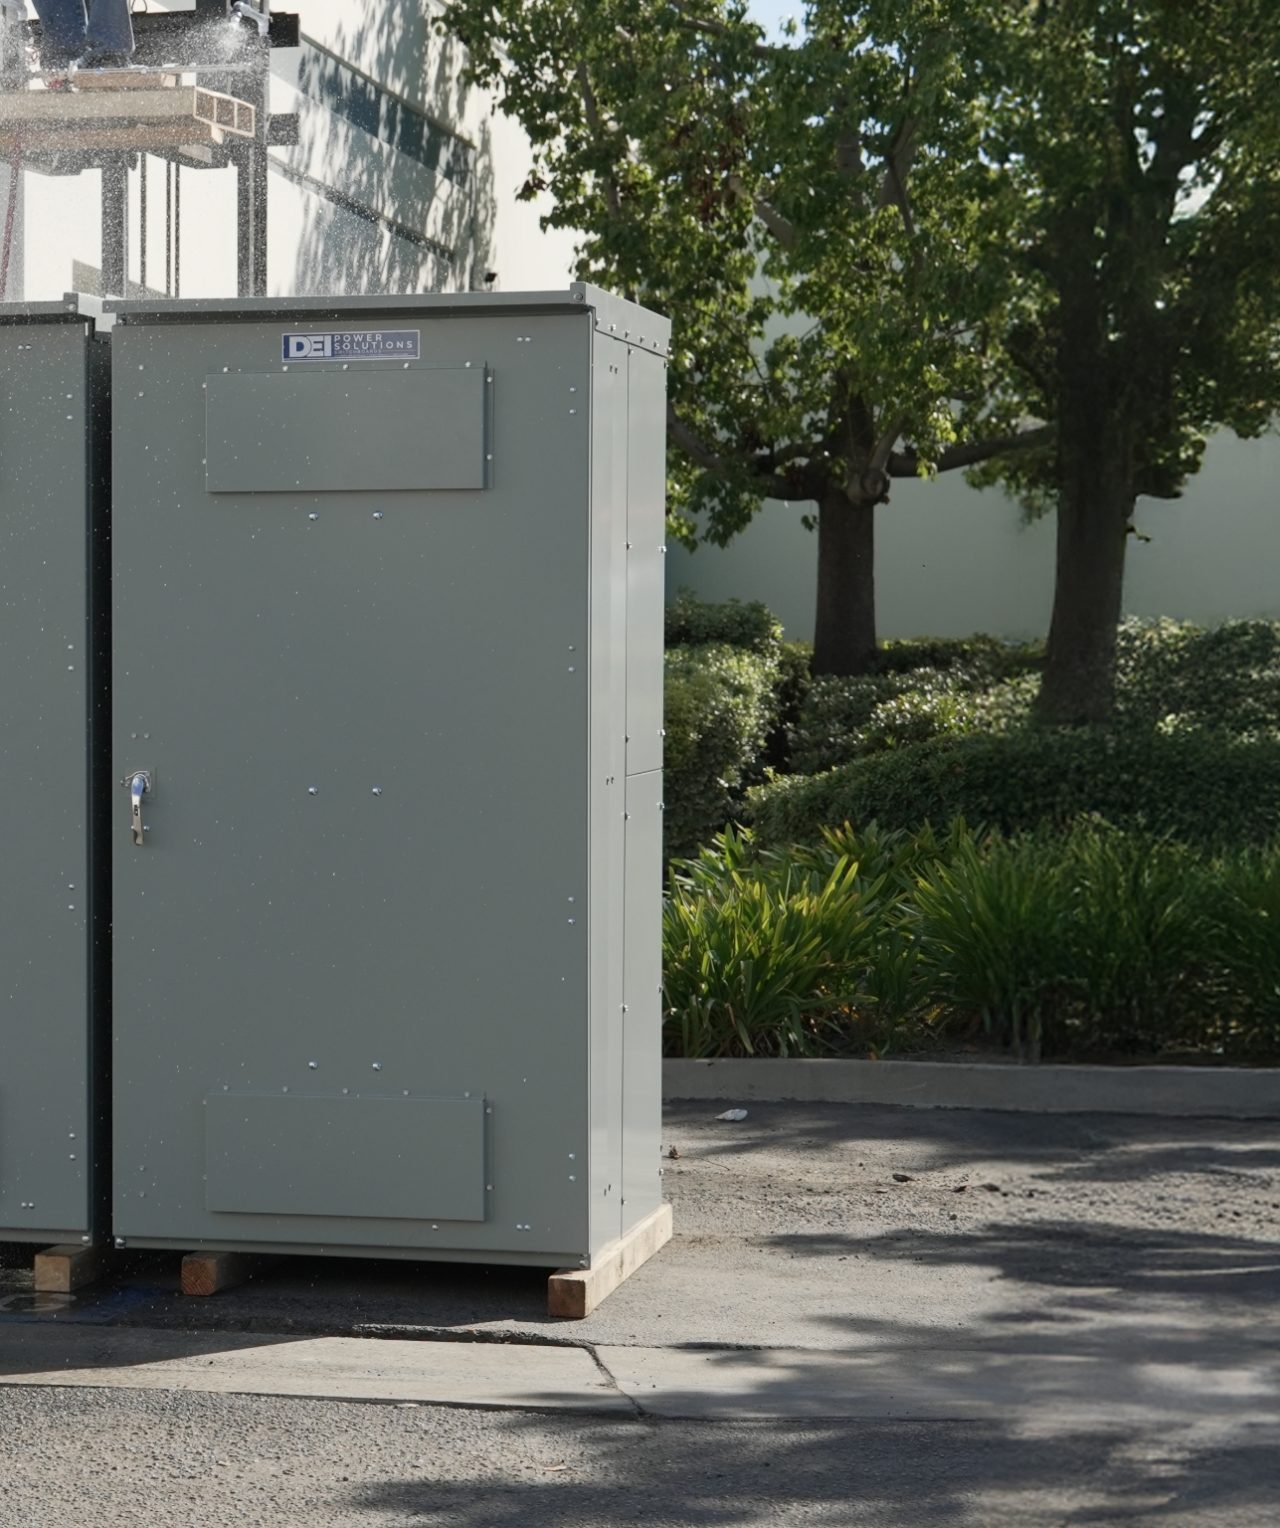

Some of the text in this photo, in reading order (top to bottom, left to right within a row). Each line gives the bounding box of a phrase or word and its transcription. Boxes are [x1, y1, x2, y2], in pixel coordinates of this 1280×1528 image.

[333, 333, 383, 342] POWER
[288, 335, 332, 358] DEI
[333, 340, 413, 350] SOLUTIONS
